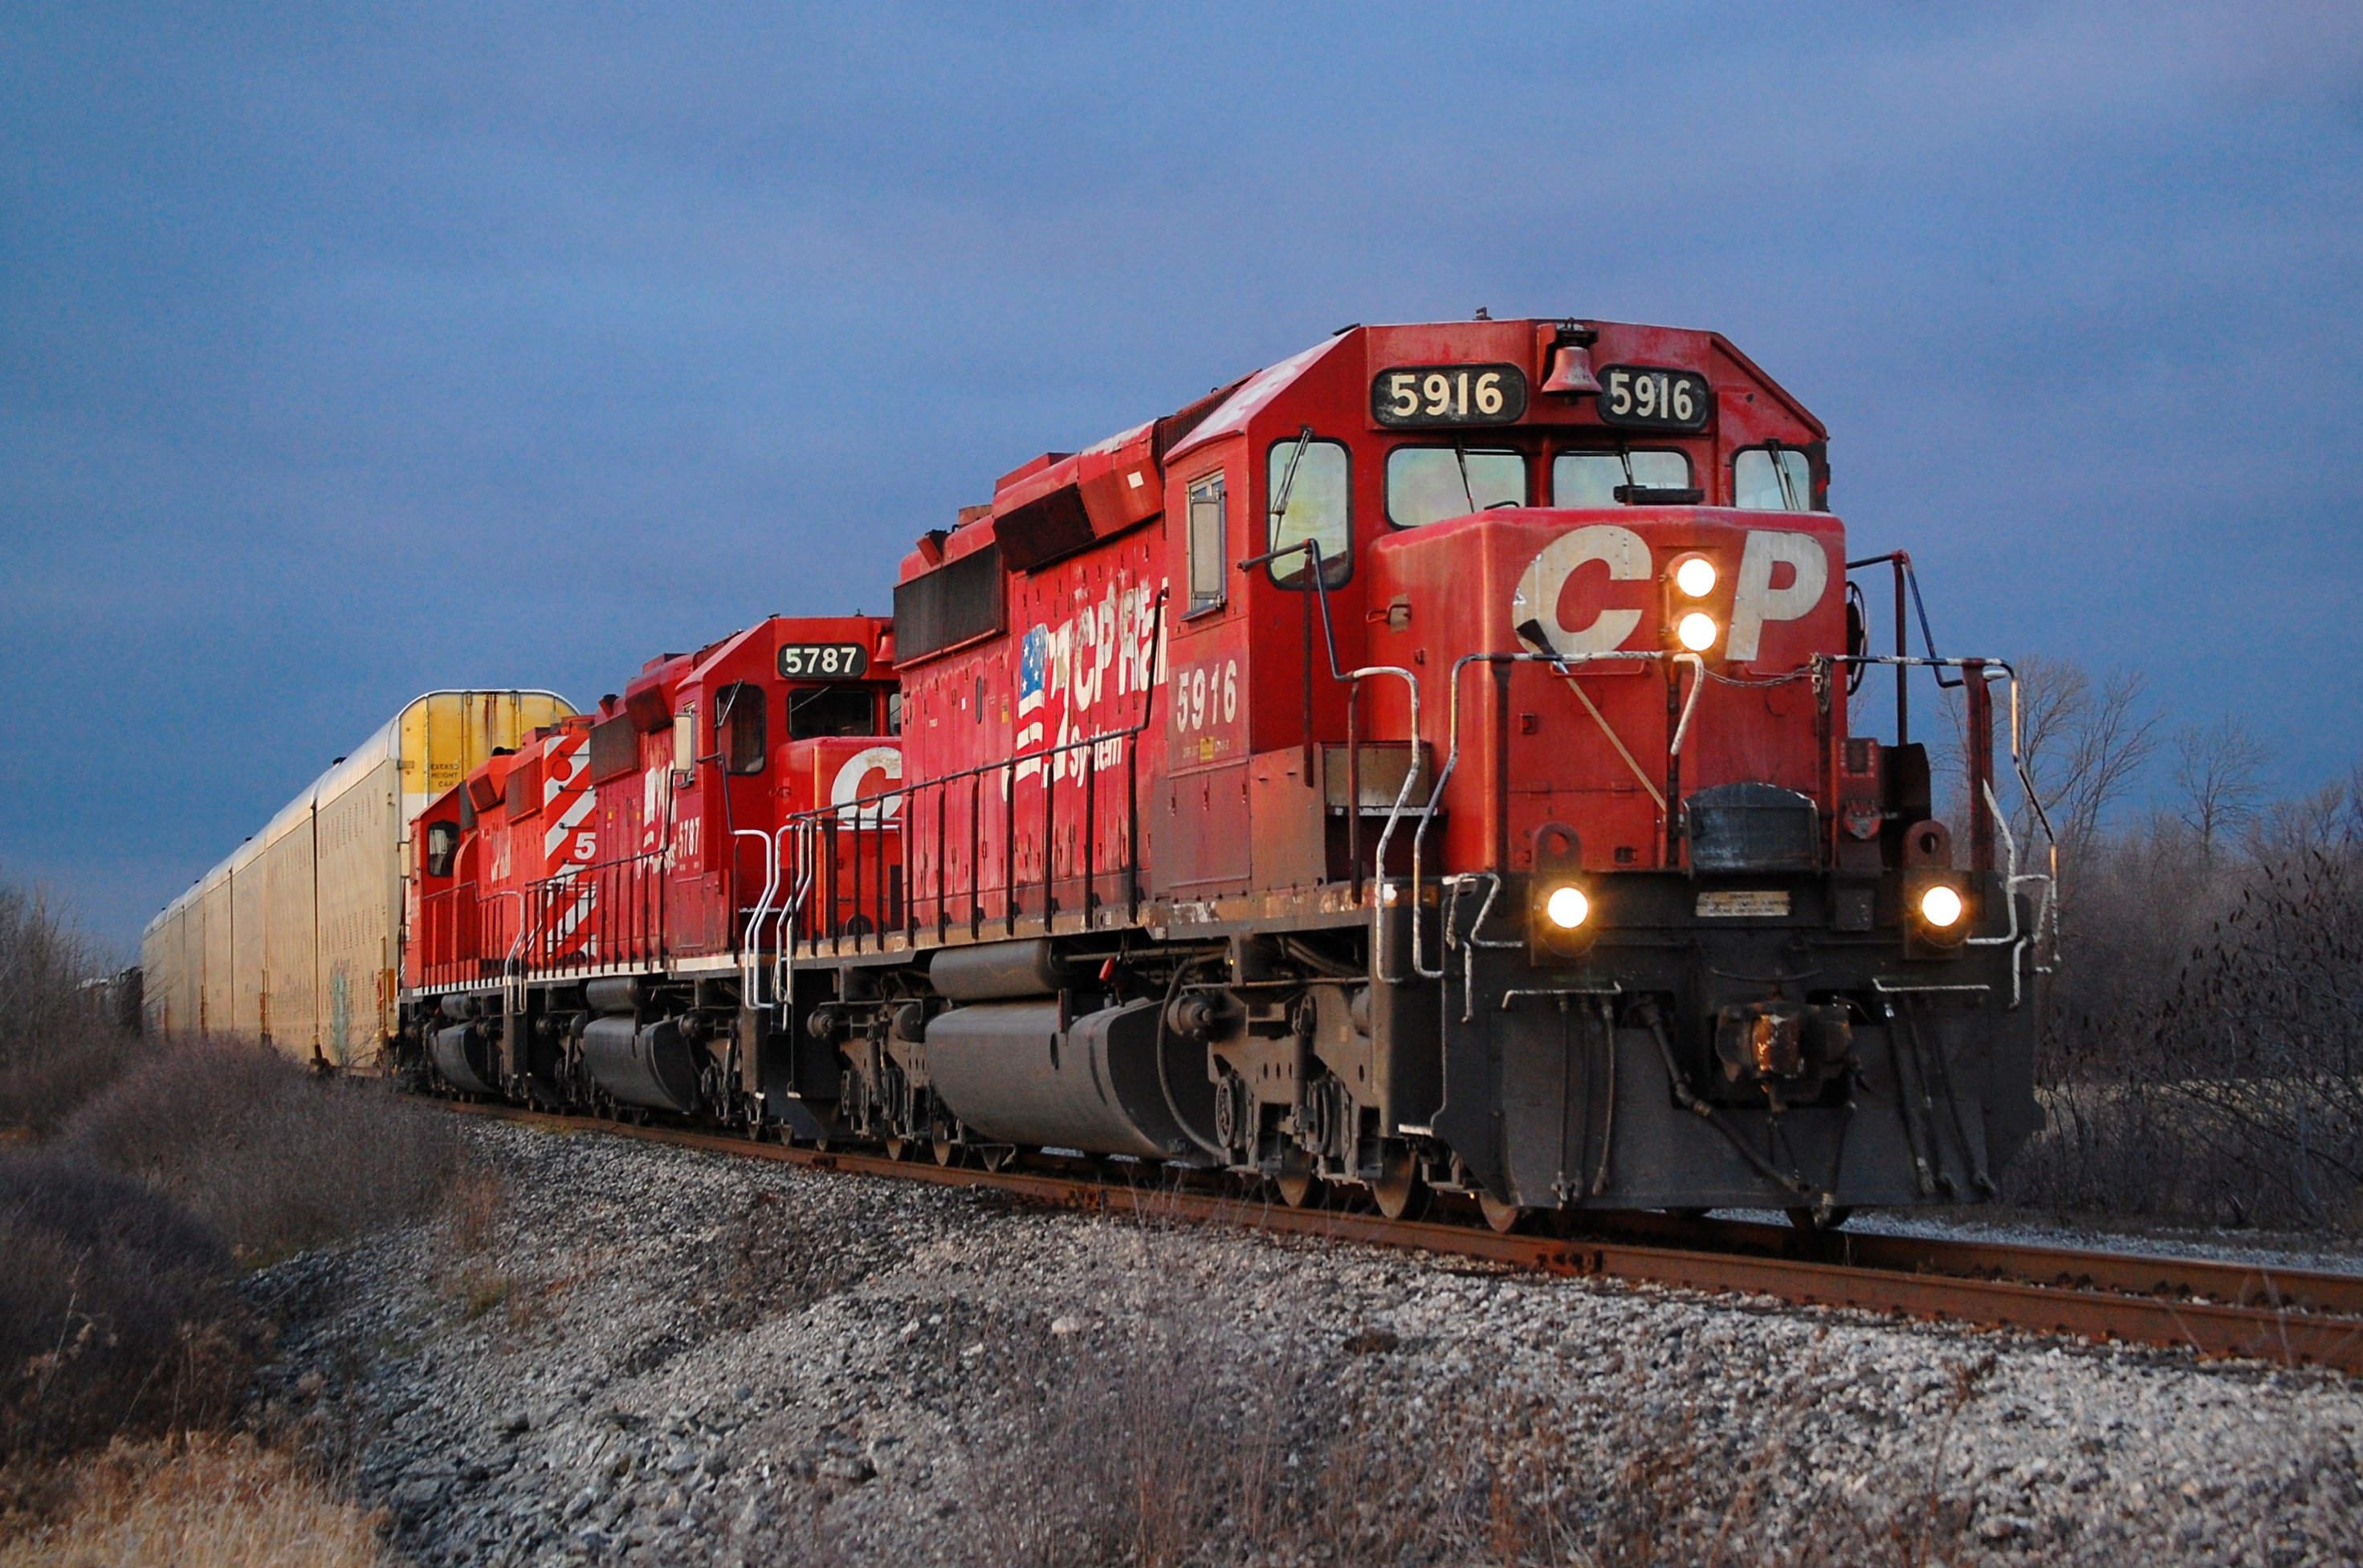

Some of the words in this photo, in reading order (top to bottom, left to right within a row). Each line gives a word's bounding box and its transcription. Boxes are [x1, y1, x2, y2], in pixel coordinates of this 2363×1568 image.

[1390, 373, 1504, 417] 5916
[1609, 373, 1693, 420] 5916
[1118, 576, 1169, 696] Rai
[785, 646, 858, 674] 5787
[1176, 659, 1237, 732] 5916
[430, 763, 459, 771] EXCESS
[678, 816, 701, 859] 5787
